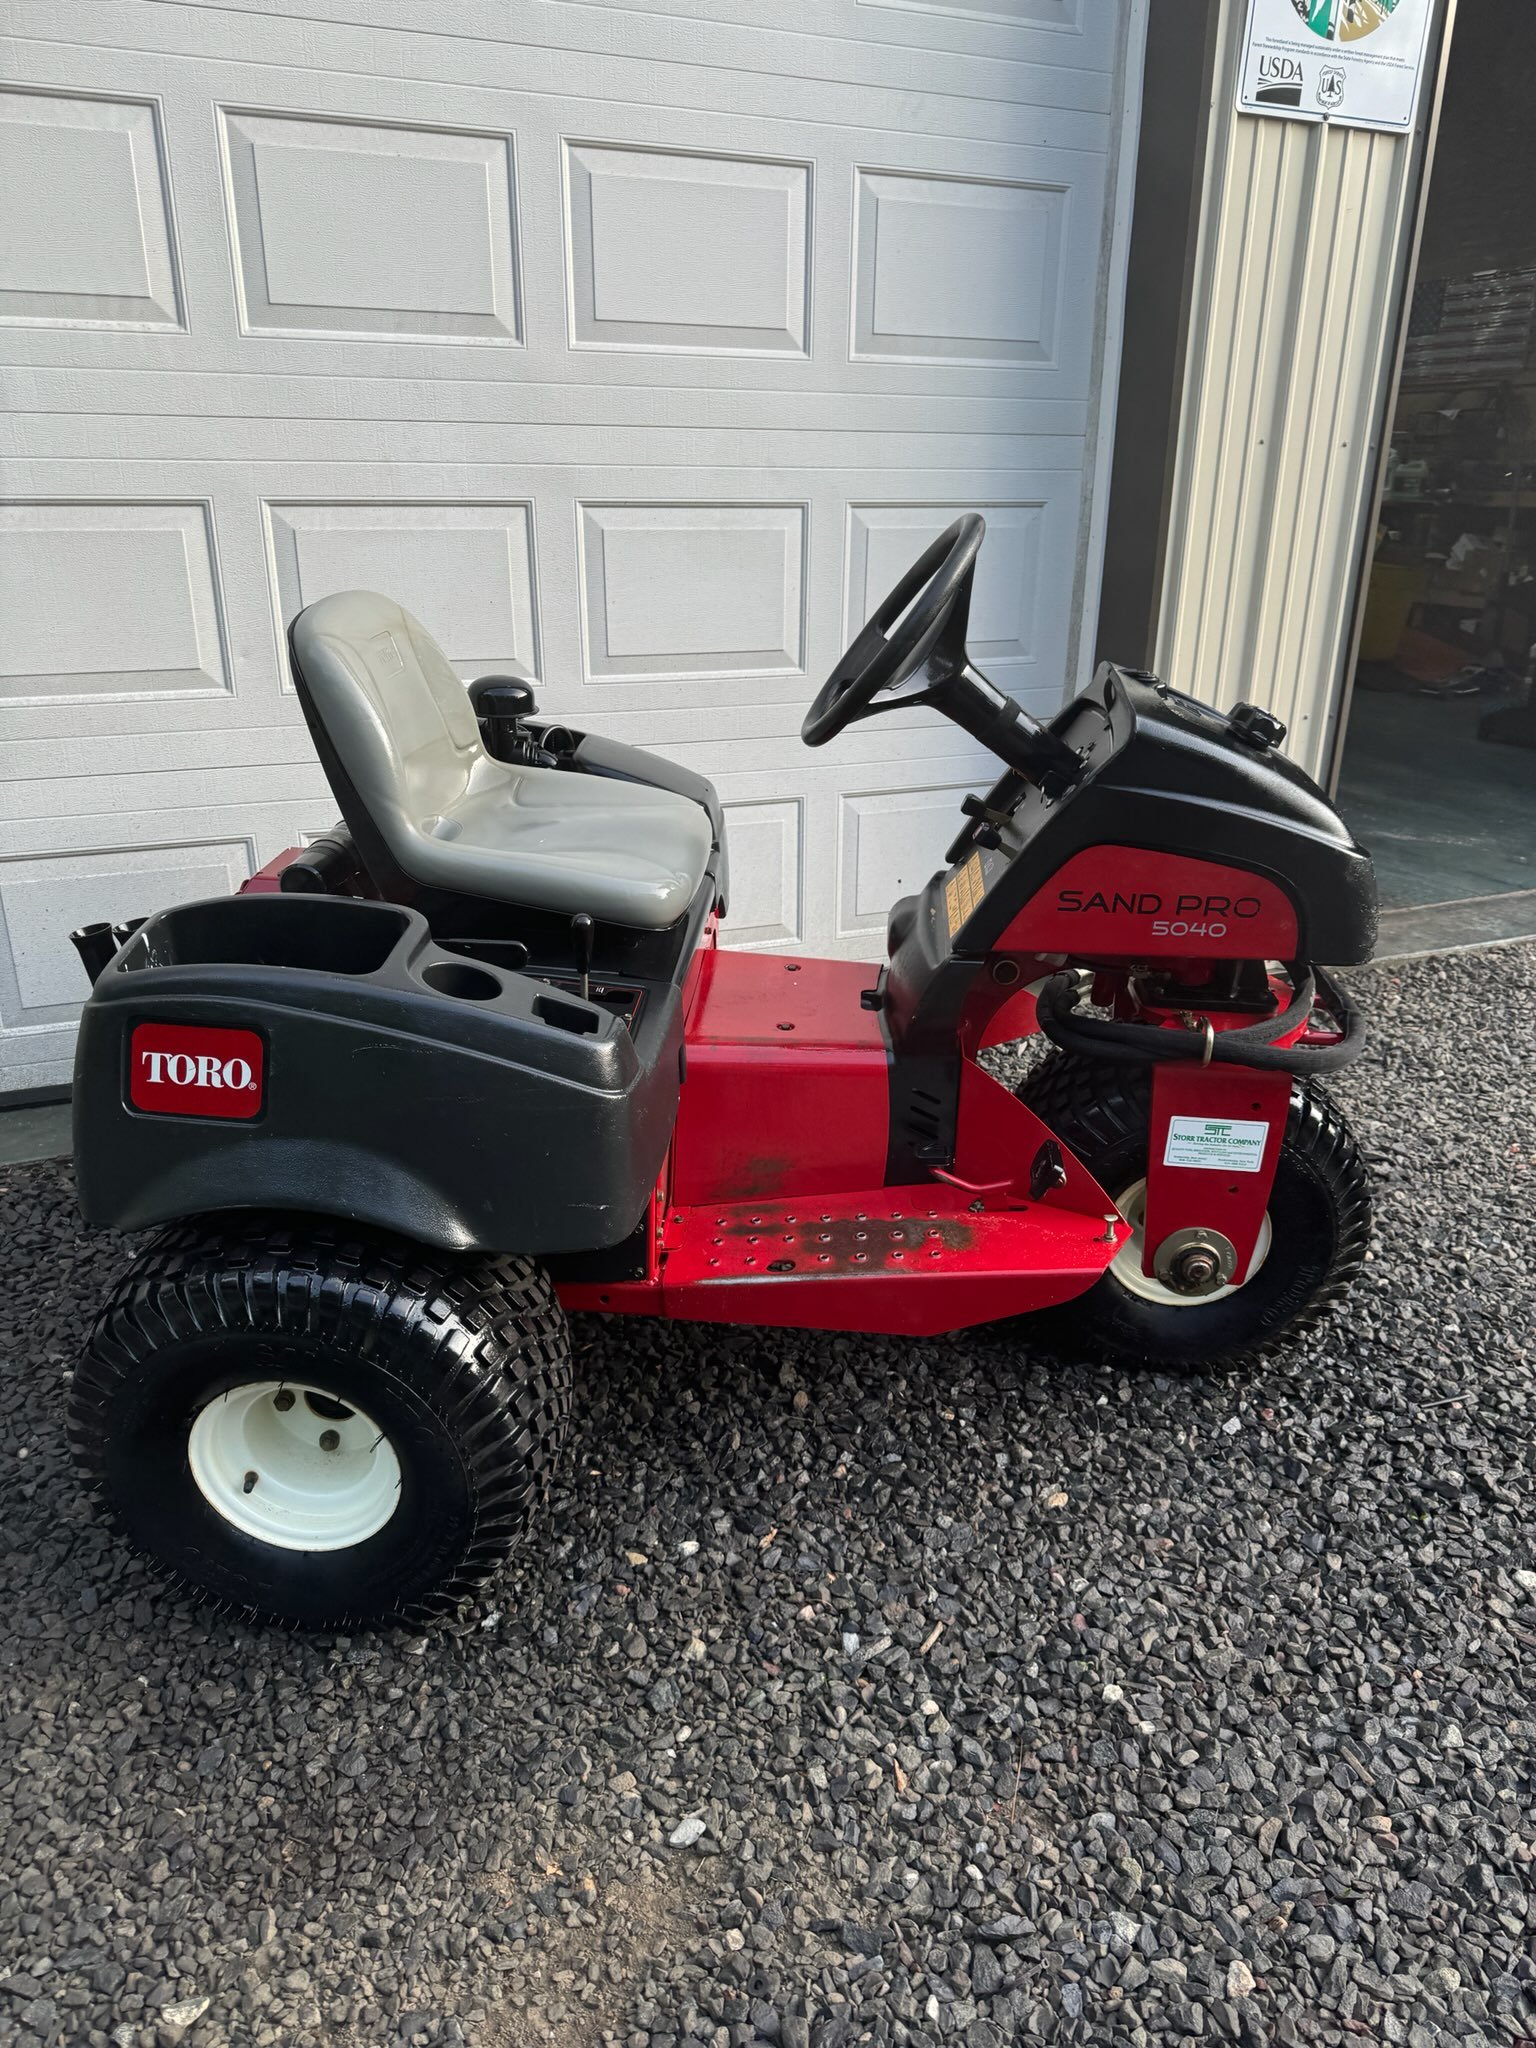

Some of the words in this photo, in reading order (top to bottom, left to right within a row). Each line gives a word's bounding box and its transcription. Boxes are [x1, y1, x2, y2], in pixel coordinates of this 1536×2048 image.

[1259, 55, 1303, 81] USDA
[1057, 890, 1162, 915] SAND
[1175, 895, 1262, 918] PRO
[1152, 921, 1227, 937] 5040
[1204, 1124, 1232, 1137] STC
[1173, 1133, 1195, 1142] STORR
[1196, 1135, 1227, 1144] TRACTOR
[1228, 1137, 1261, 1147] COMPANY
